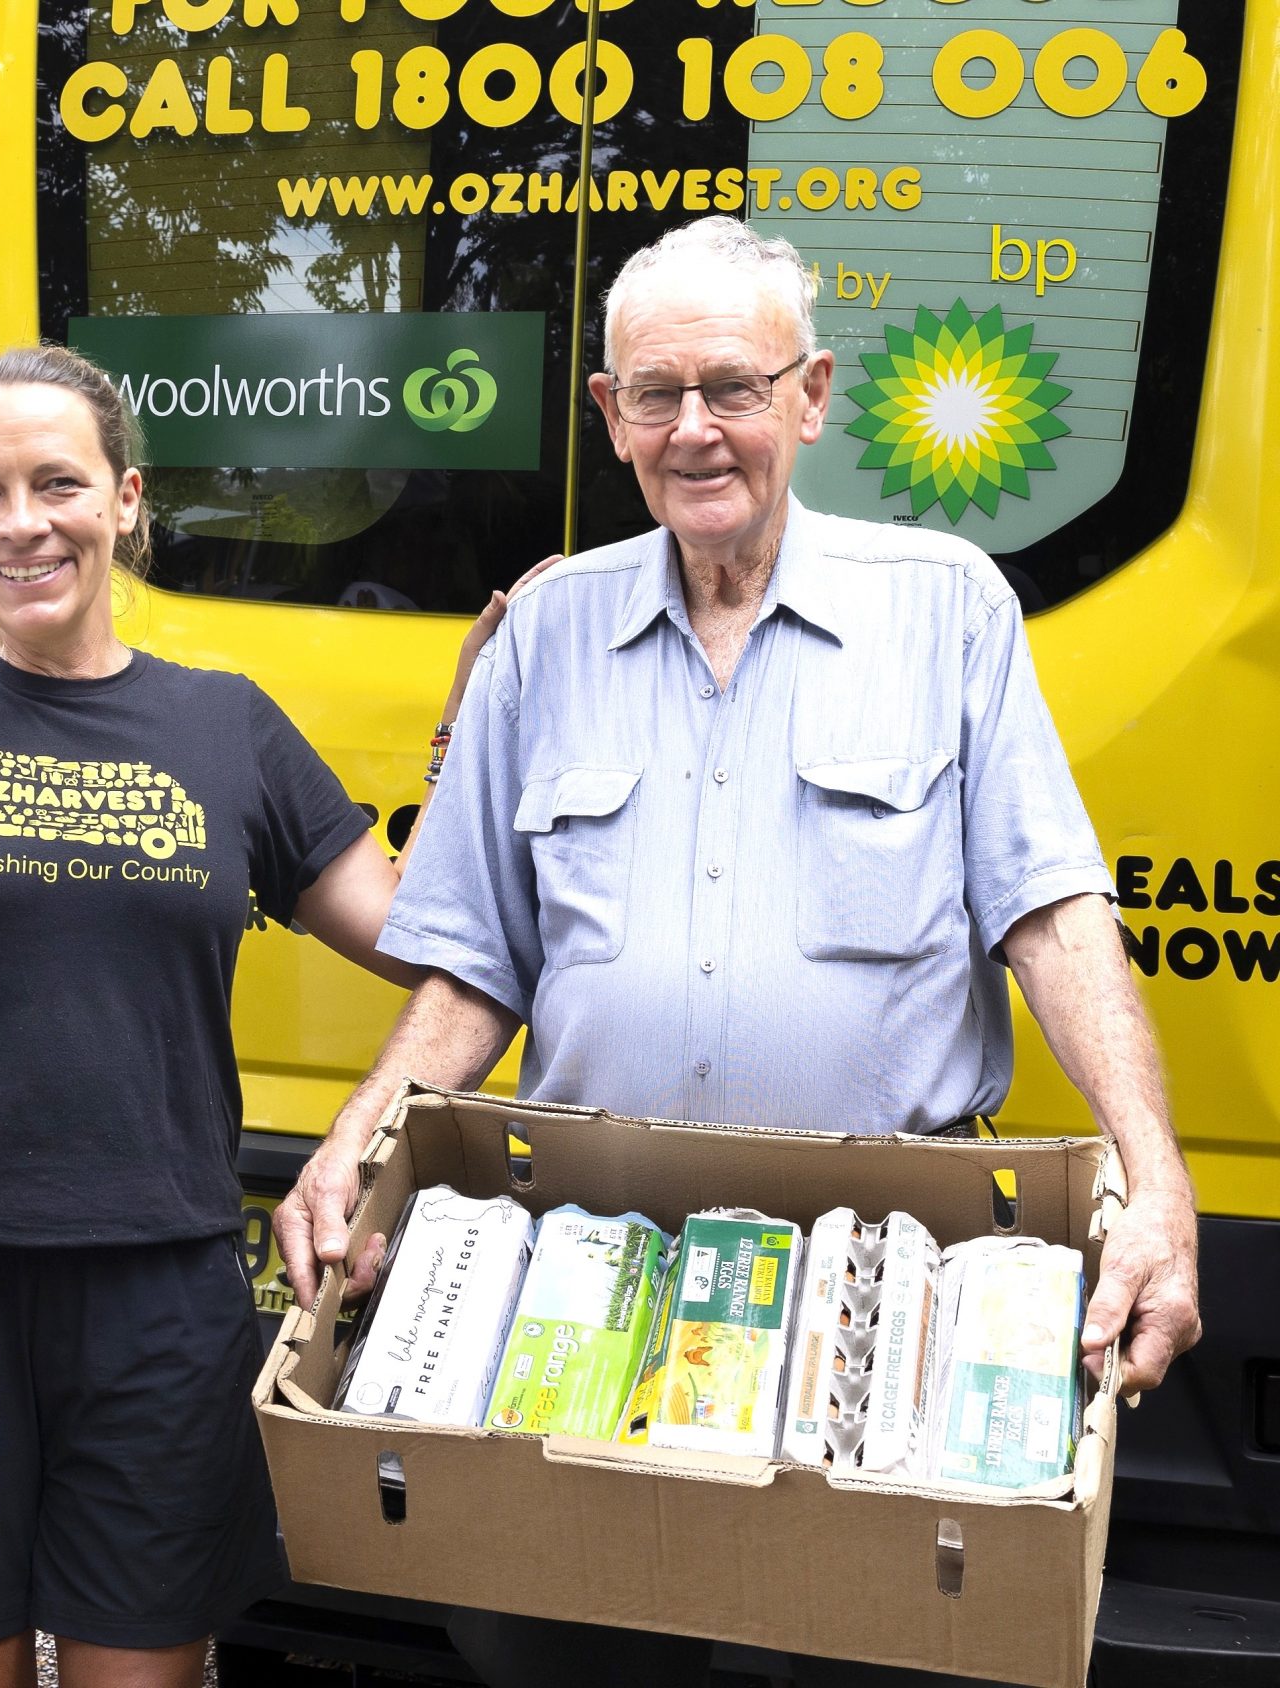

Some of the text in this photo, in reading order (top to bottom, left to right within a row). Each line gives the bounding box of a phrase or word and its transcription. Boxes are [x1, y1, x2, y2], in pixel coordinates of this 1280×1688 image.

[60, 27, 1208, 142] CALL 1800 108 006
[277, 166, 922, 218] WWW.OZHARVEST.ORG
[836, 262, 892, 310] by
[991, 224, 1078, 296] bp
[103, 363, 391, 418] woolworths
[67, 857, 114, 882] Our
[134, 860, 211, 890] Country
[1116, 855, 1280, 916] EALS
[718, 1260, 735, 1289] EGGS
[729, 1237, 754, 1318] 12 FREE RANGE
[762, 1260, 775, 1301] AUSTRALIAN
[387, 1326, 420, 1362] lake
[414, 1245, 445, 1324] macquarie
[415, 1228, 479, 1395] FREE RANGE EGGS
[880, 1310, 907, 1433] 12 CAGE FREE EGGS
[990, 1375, 1011, 1418] RANGE
[986, 1418, 1006, 1452] FREE
[1006, 1405, 1024, 1442] EGGS
